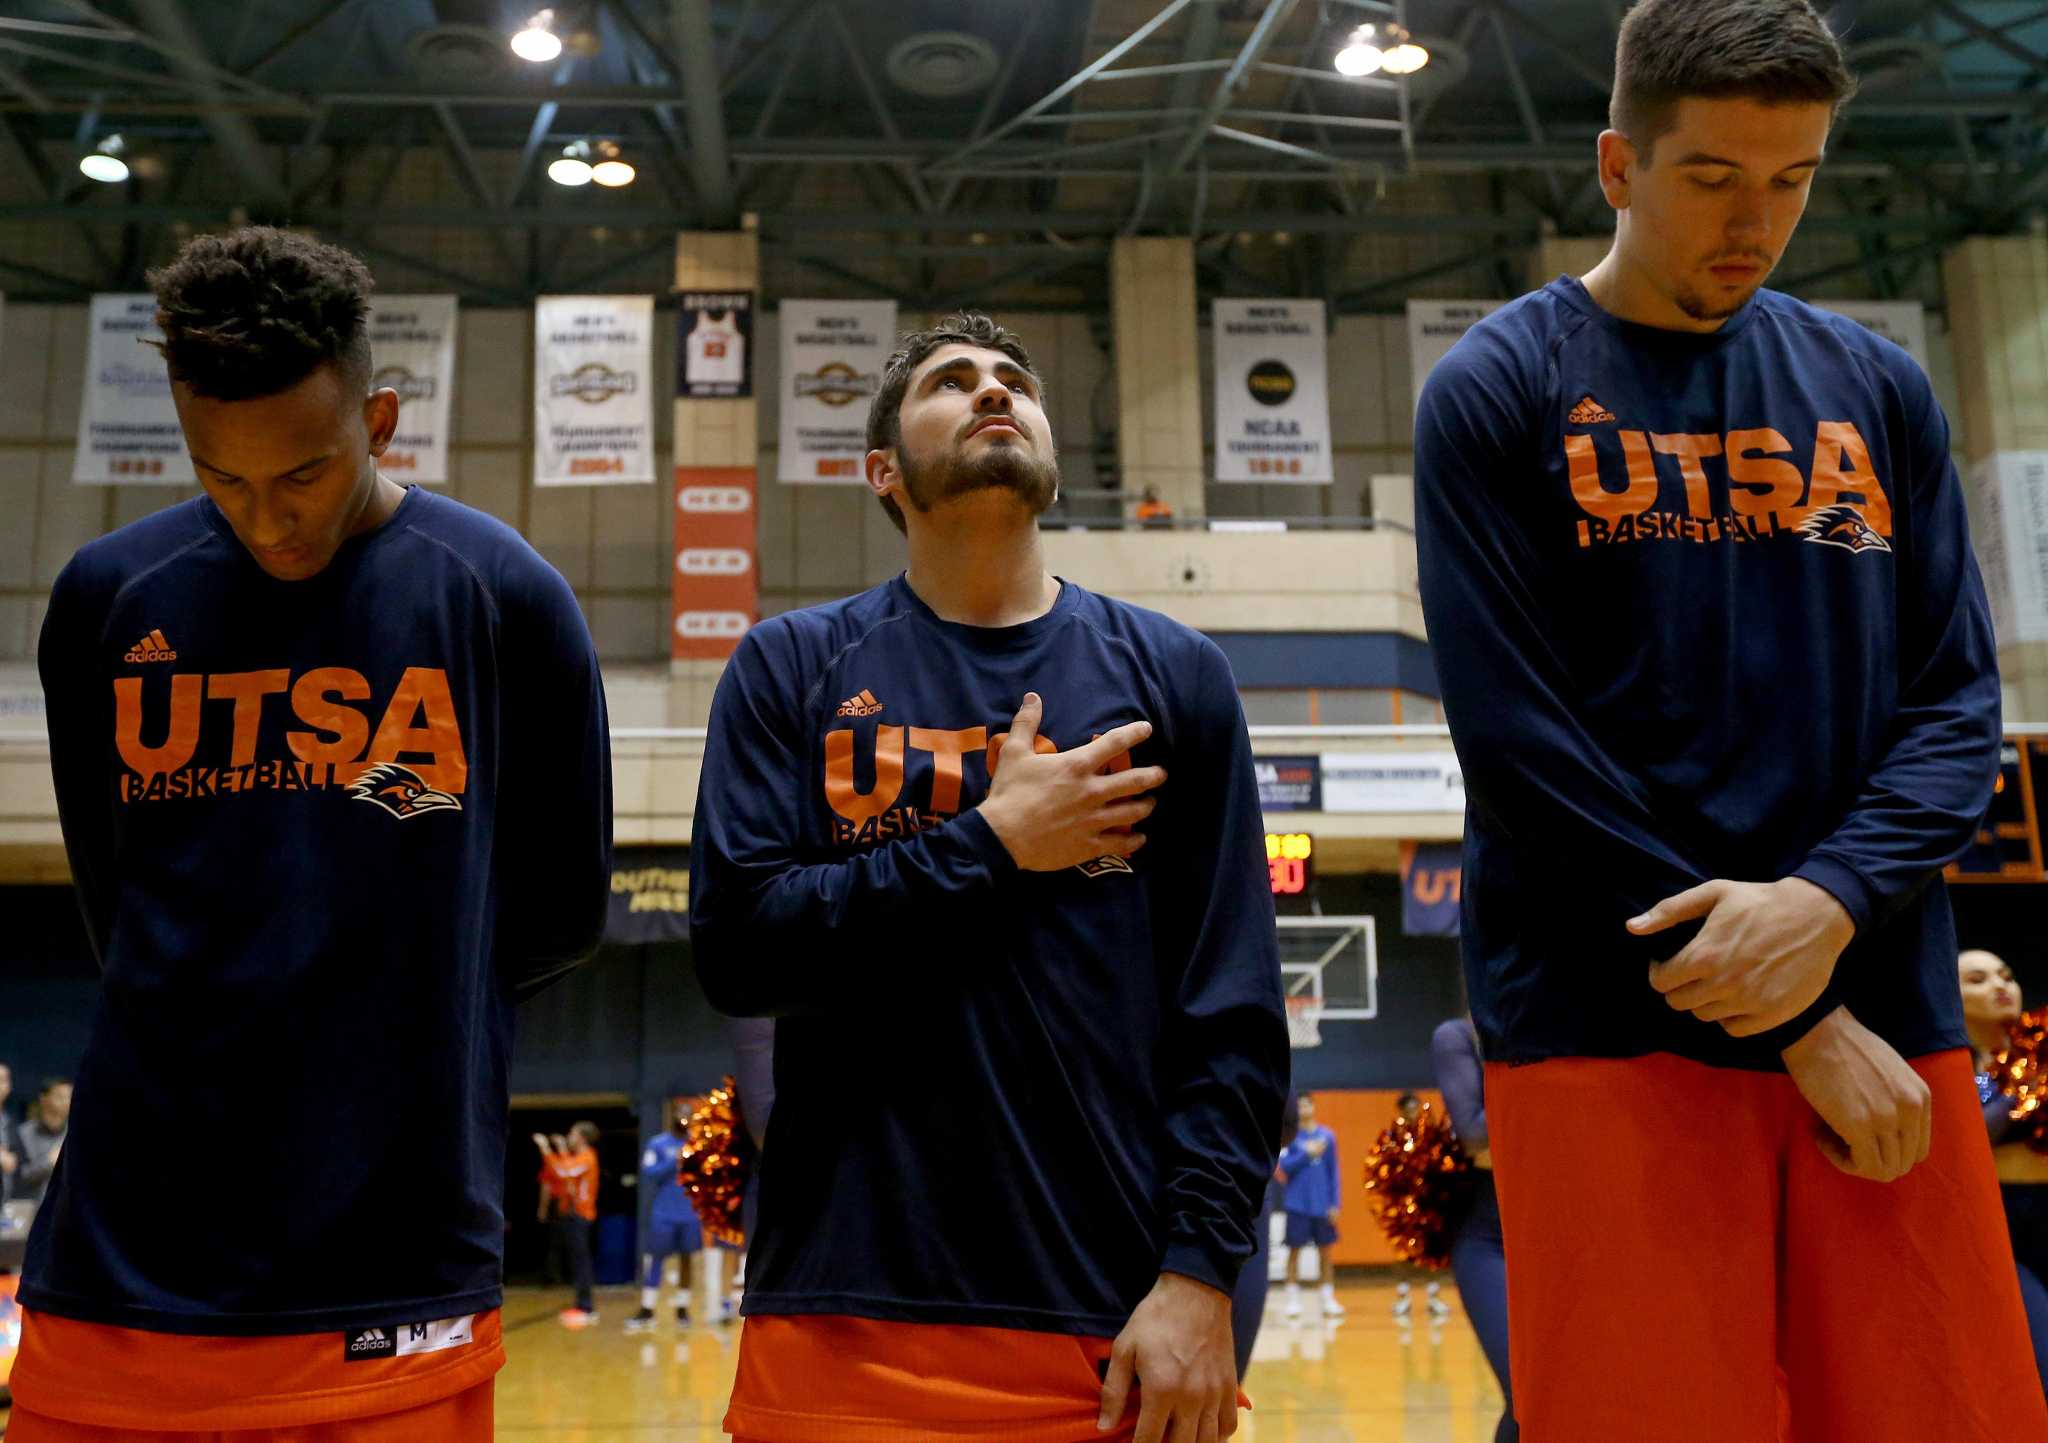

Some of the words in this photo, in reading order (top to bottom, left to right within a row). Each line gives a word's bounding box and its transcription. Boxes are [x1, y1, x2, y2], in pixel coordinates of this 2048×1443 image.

[1564, 420, 1892, 537] UTSA
[1588, 511, 1794, 545] BASKETBALL
[123, 648, 177, 664] adidas
[836, 702, 884, 718] adidas
[113, 666, 468, 795] UTSA
[127, 761, 347, 801] BASKETBALL
[410, 1321, 427, 1341] M
[351, 1339, 392, 1351] adidas
